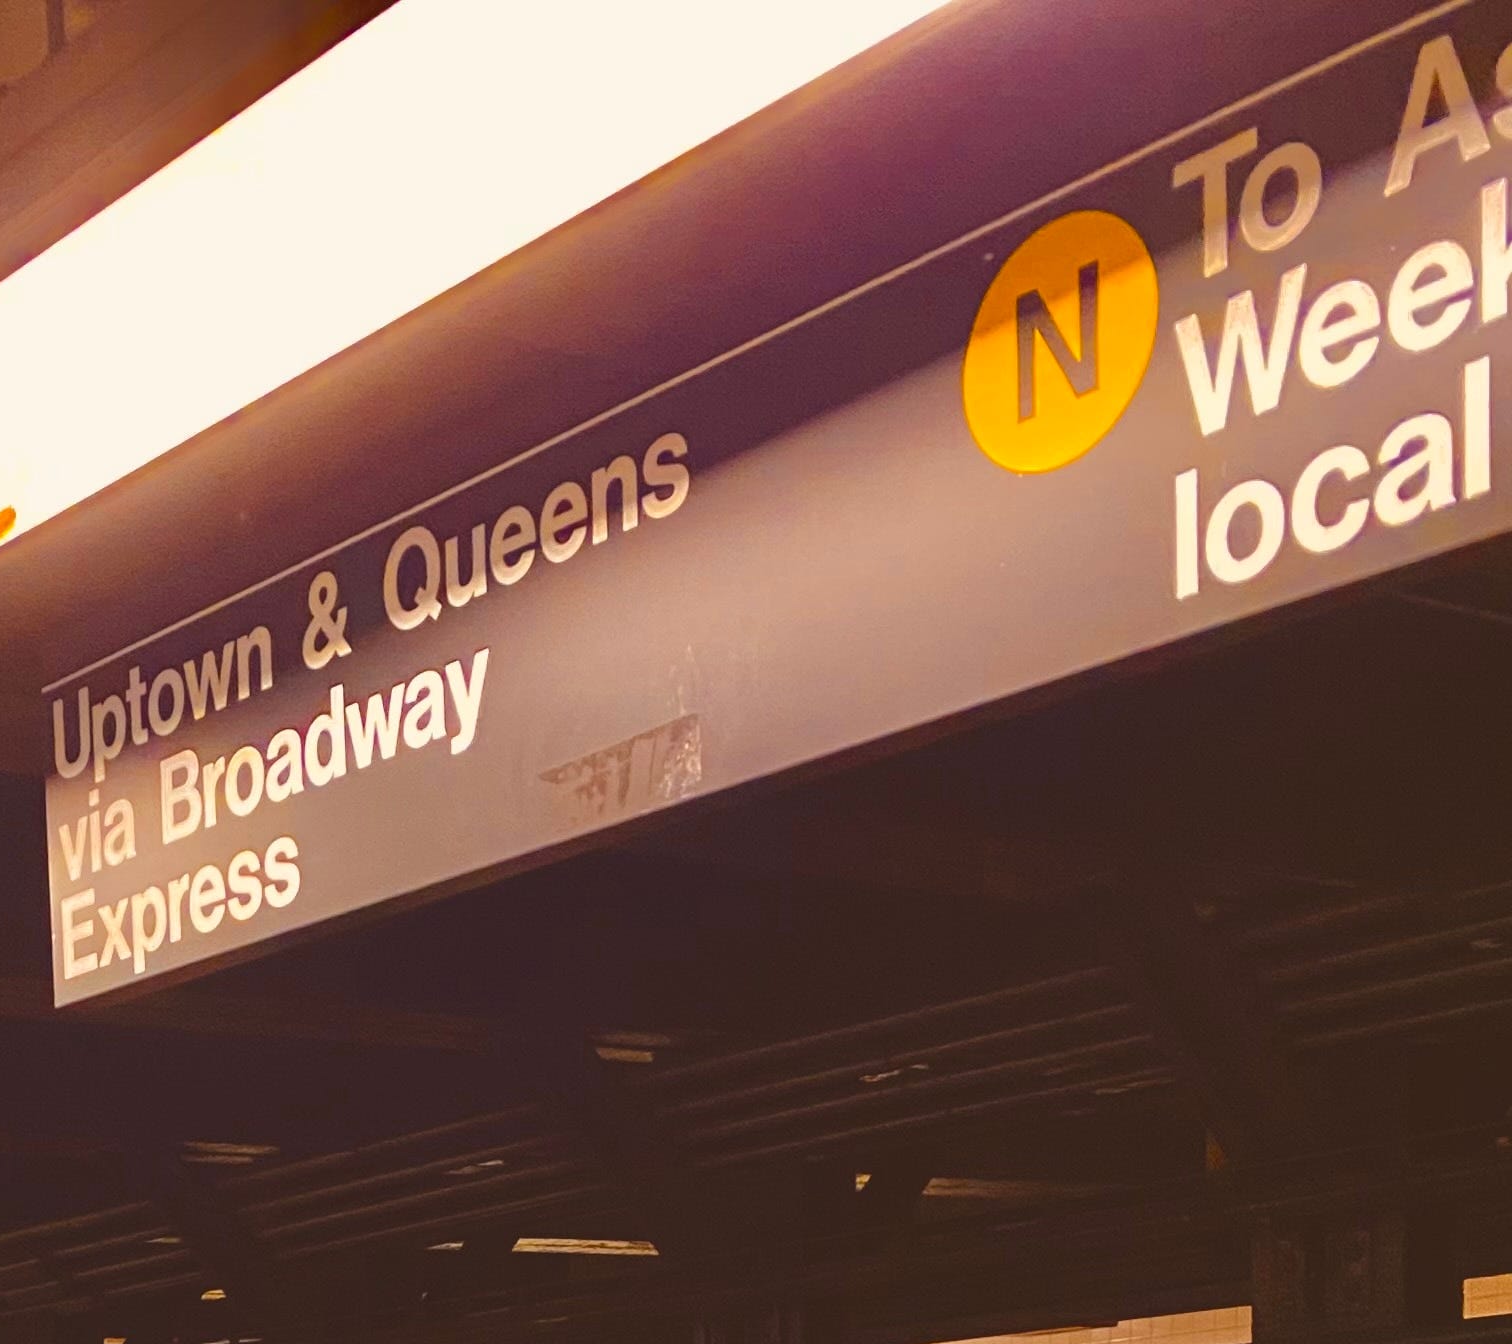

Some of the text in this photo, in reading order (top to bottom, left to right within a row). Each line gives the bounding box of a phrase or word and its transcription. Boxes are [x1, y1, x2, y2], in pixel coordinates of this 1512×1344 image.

[1172, 126, 1323, 278] To
[1015, 259, 1099, 424] N
[1174, 355, 1491, 600] local
[52, 431, 691, 782] Uptown & Queens
[58, 647, 490, 881] via Broadway
[60, 835, 302, 979] Express
